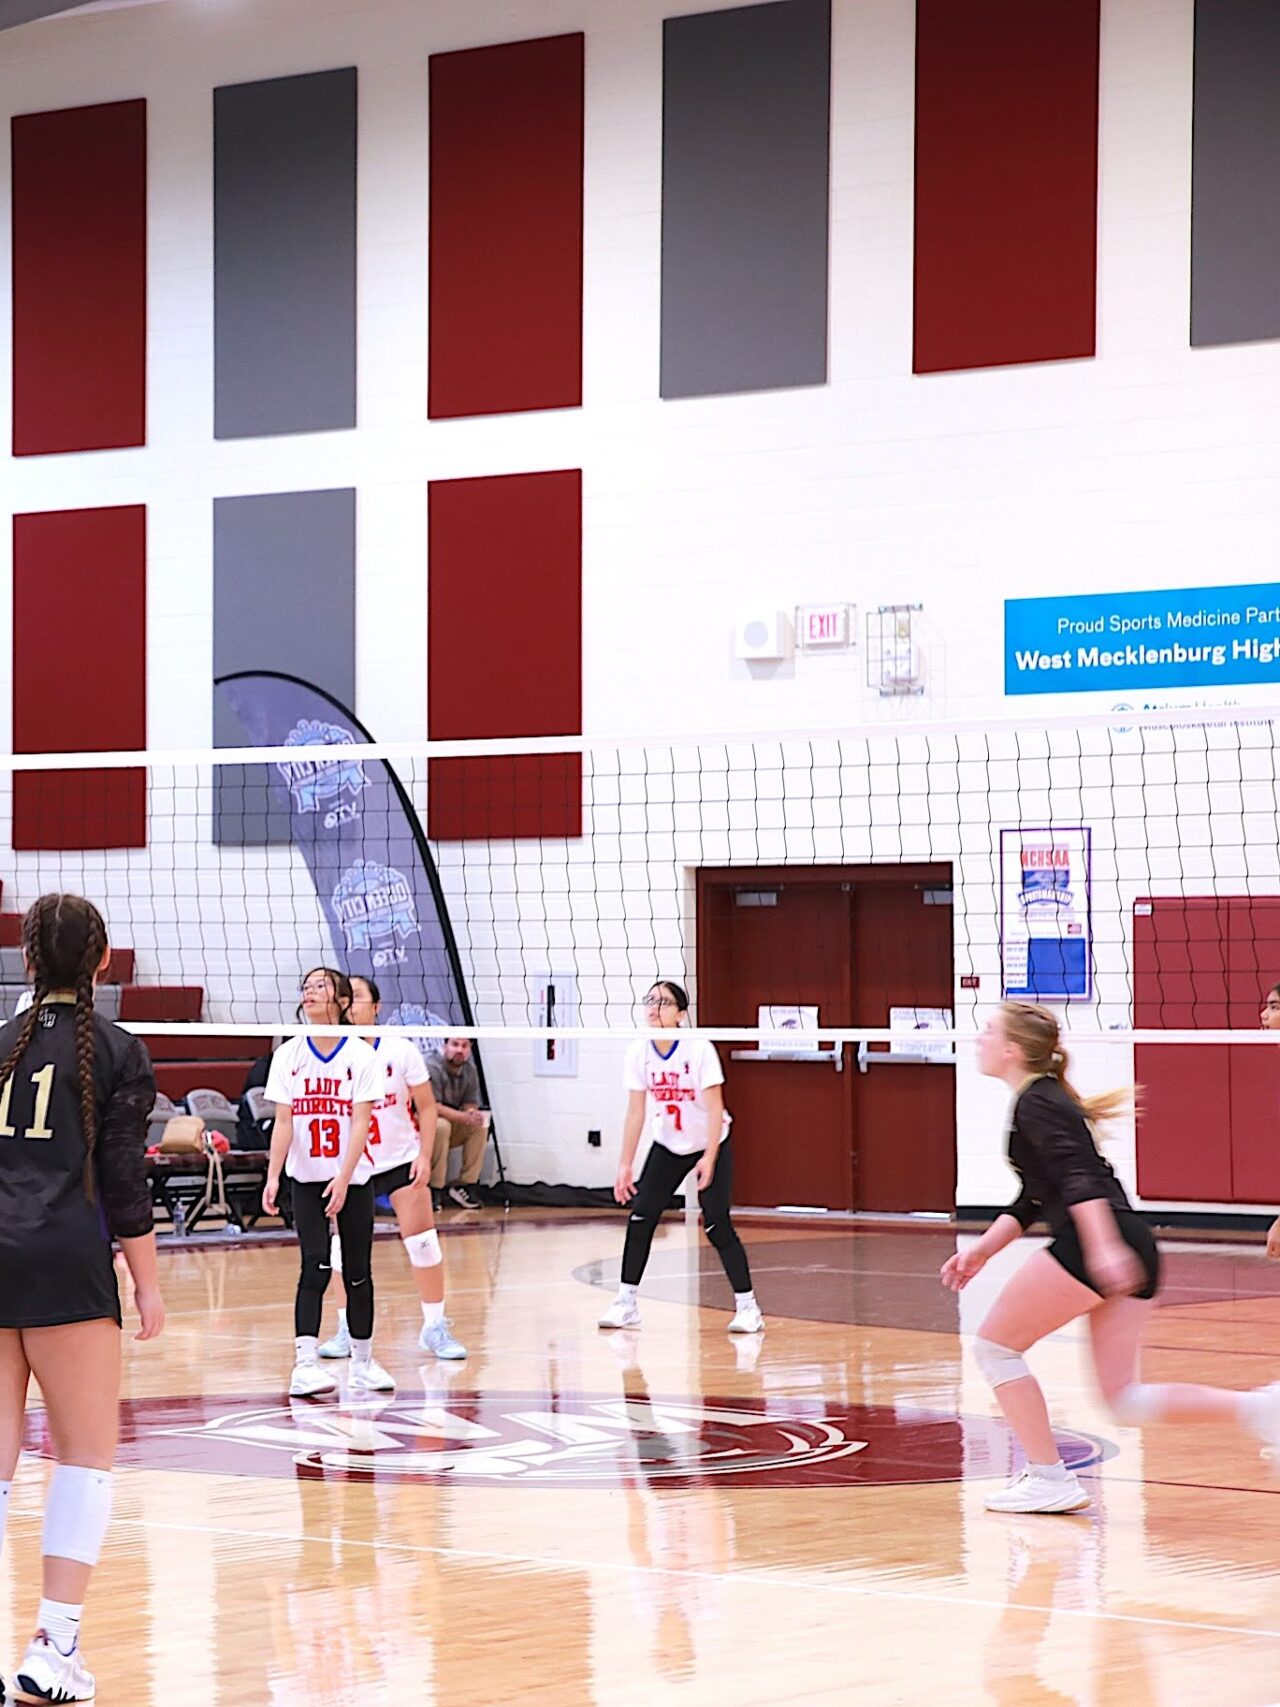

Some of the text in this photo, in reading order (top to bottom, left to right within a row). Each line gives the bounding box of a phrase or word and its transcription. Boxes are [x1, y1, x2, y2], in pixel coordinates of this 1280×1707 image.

[809, 613, 838, 639] EXIT
[1057, 616, 1104, 635] Proud
[1109, 613, 1162, 635] Sports
[1167, 608, 1241, 629] Medicine
[1015, 650, 1072, 671] West
[1077, 641, 1226, 667] Mecklenburg
[304, 1077, 342, 1097] LADY
[292, 1097, 353, 1117] HORNETS
[308, 1118, 341, 1158] 13
